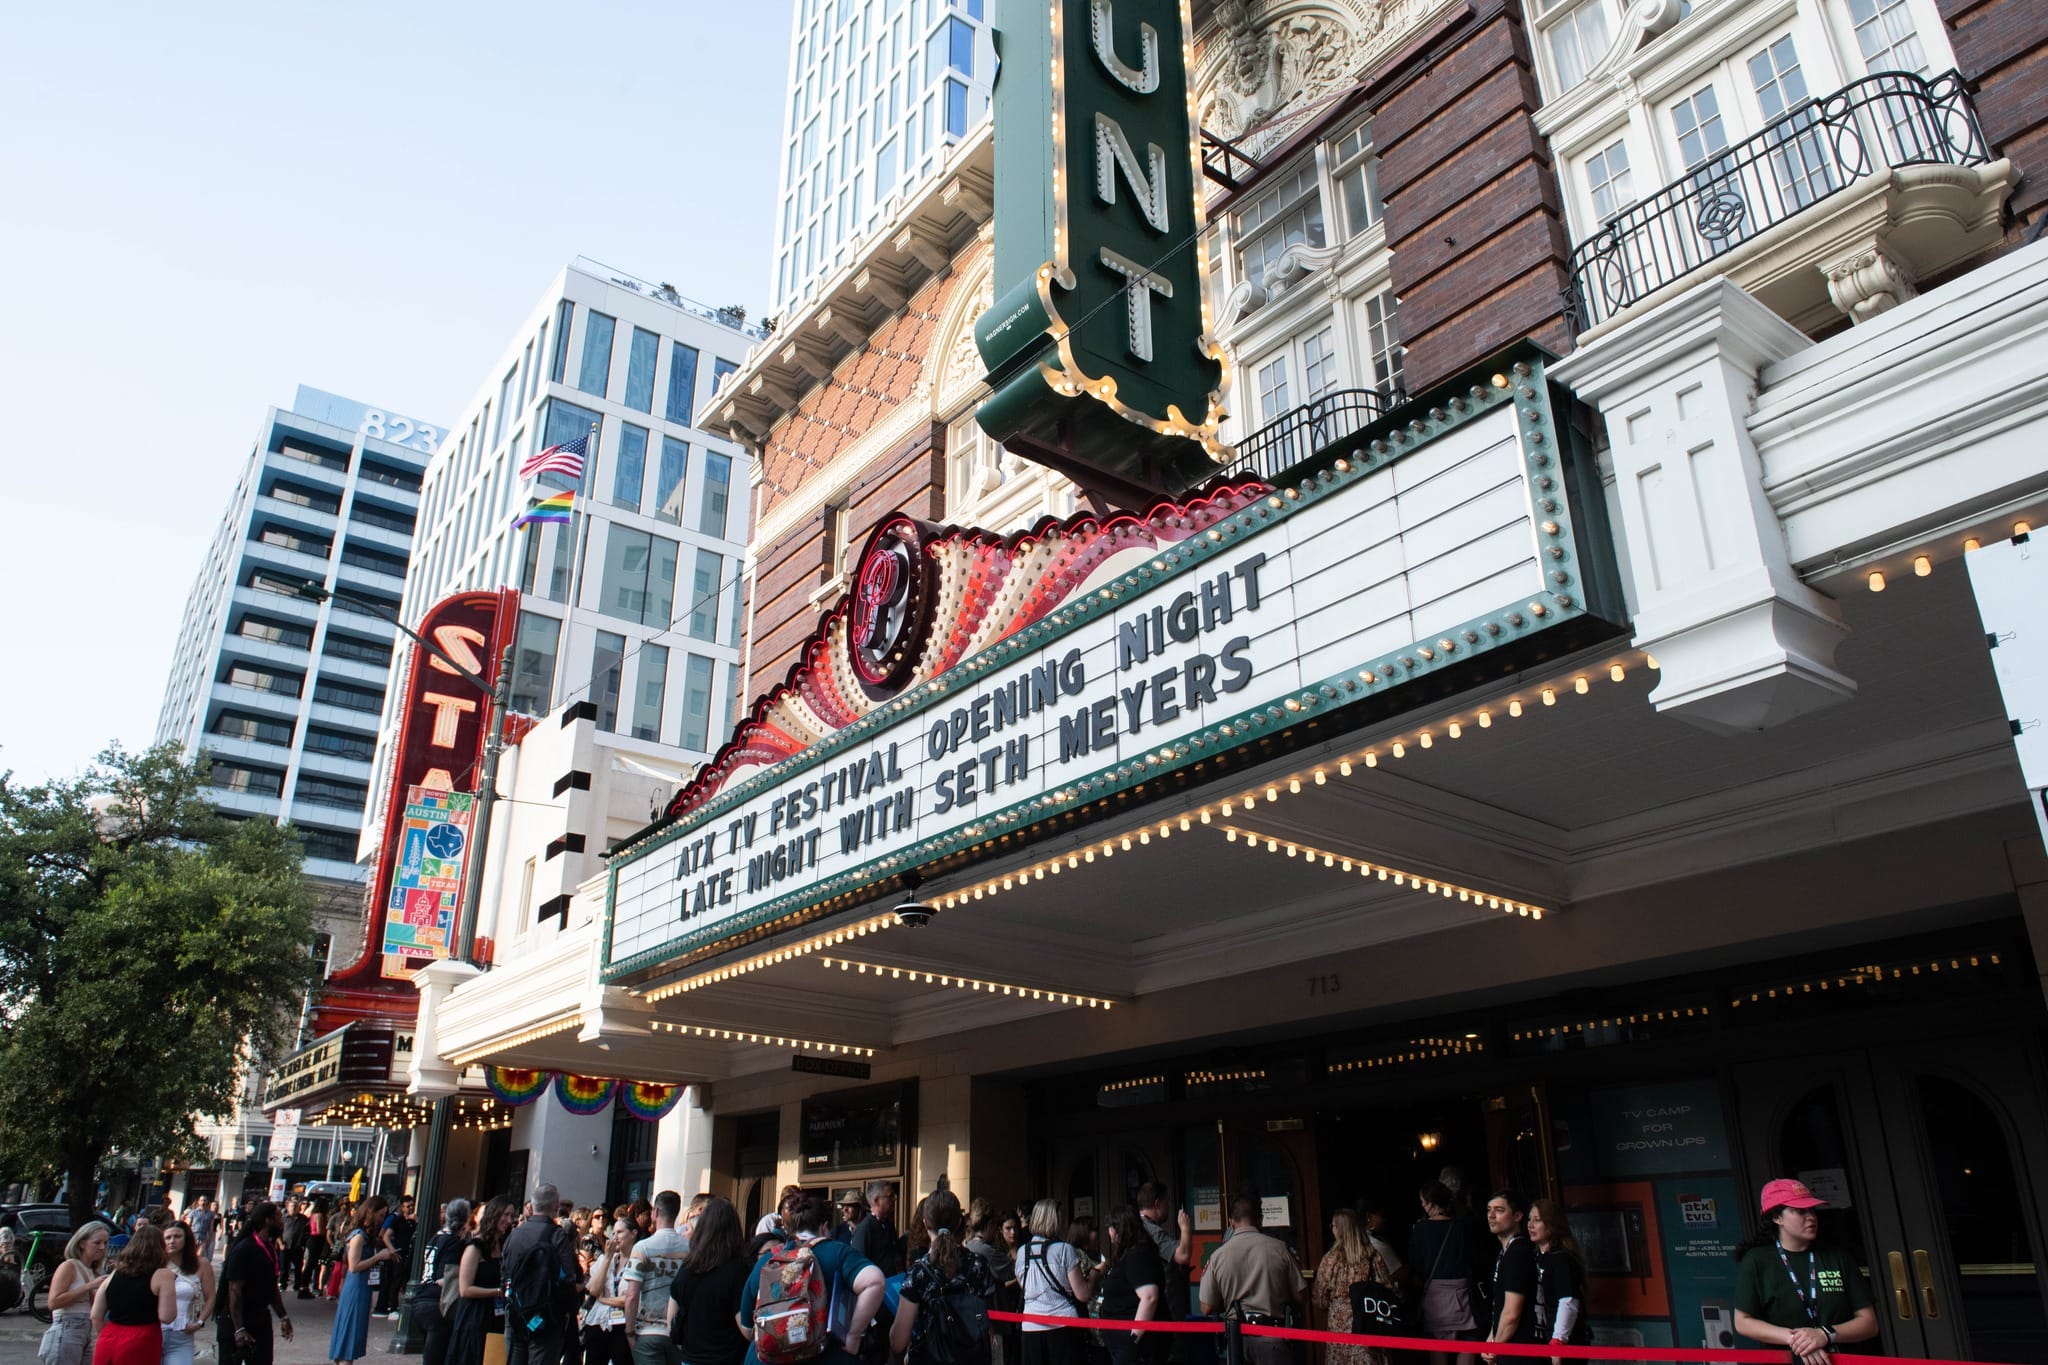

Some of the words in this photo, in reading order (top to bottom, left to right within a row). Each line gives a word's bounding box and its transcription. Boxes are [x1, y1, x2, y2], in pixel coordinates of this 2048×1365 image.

[985, 303, 1029, 342] WAGNERSIGN.COM
[360, 408, 437, 455] 823
[676, 831, 717, 881] ATX
[728, 811, 757, 854] TV
[770, 742, 902, 836] FESTIVAL
[927, 648, 1085, 761] OPENING
[1119, 552, 1266, 671] NIGHT
[680, 867, 734, 921] LATE
[747, 827, 821, 894] NIGHT
[840, 787, 914, 855] WITH
[934, 733, 1029, 815] SETH
[1059, 636, 1253, 764] MEYERS
[425, 790, 448, 798] HOWDY
[407, 807, 449, 820] AUSTIN
[431, 880, 456, 889] TEXAS
[401, 947, 432, 957] Y'ALL
[1306, 975, 1341, 997] 713
[1622, 1111, 1641, 1119] TV
[1646, 1105, 1691, 1118] CAMP
[1642, 1124, 1673, 1133] FOR
[1616, 1139, 1673, 1151] GROWN
[1675, 1136, 1706, 1147] UPS
